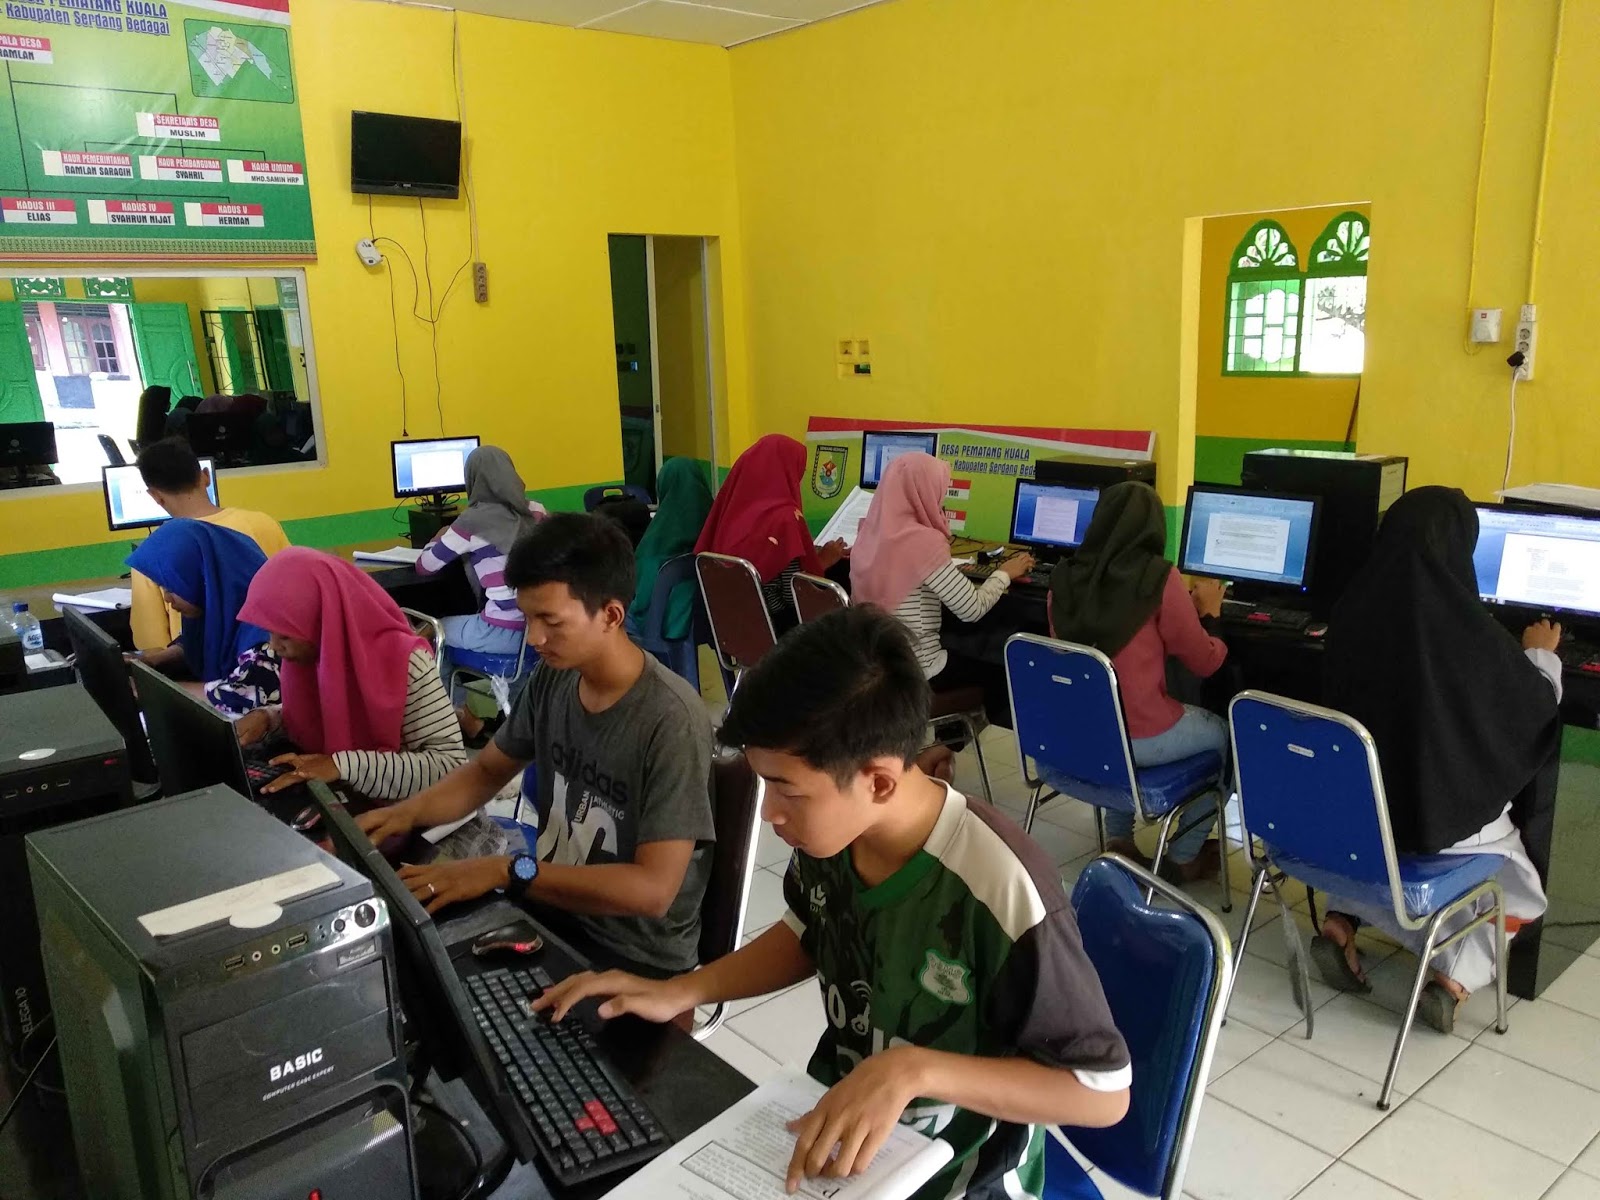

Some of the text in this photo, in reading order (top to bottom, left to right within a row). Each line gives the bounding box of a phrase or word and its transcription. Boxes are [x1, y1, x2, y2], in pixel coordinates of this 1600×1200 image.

[126, 0, 167, 18] KUALA
[6, 3, 170, 35] Kabupaten Serdang Bedagai
[20, 37, 42, 49] DESA
[156, 115, 218, 128] SEKRETARIS DESA
[169, 129, 206, 138] MUSLIM
[63, 153, 81, 163] KAUR
[158, 158, 175, 167] KAUR
[65, 165, 131, 177] RAMLAN SARAGIH
[251, 162, 294, 172] KAUR UMUM
[175, 170, 205, 180] SYAHRIL
[251, 175, 286, 183] MHD.SAMIN
[16, 200, 56, 210] KADUS III
[121, 202, 157, 211] KADUS IV
[217, 205, 241, 213] KADUS
[27, 212, 51, 221] ELIAS
[111, 214, 172, 224] SYAHRUN NIJAT
[218, 216, 250, 225] HERMAN
[941, 443, 1030, 461] DESA PEMATANG KUALA
[954, 460, 987, 474] Kabupaten
[989, 461, 1018, 476] Serdang
[574, 790, 590, 823] URBAN
[269, 1047, 323, 1082] BASIC
